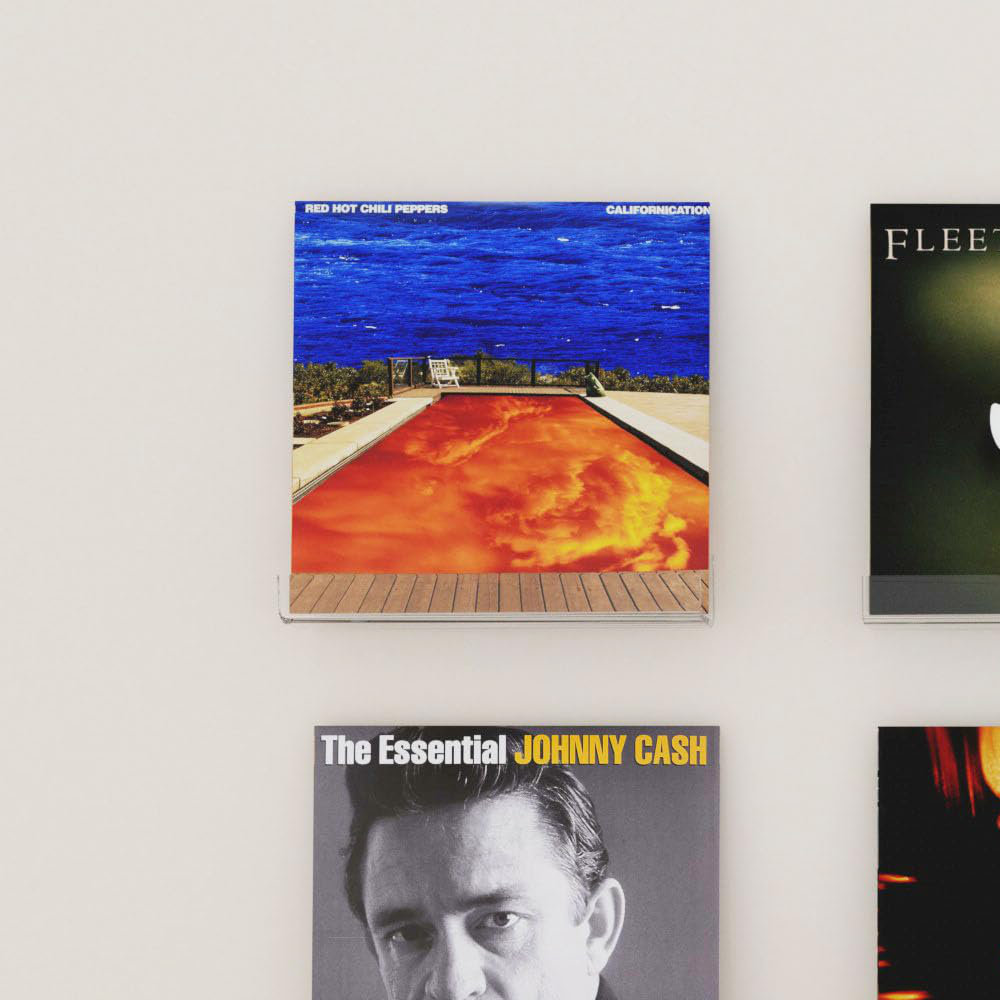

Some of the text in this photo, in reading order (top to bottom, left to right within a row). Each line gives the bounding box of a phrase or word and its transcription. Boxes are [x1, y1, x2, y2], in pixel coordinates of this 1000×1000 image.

[304, 203, 448, 214] RED HOT CHILI PEPPERS
[606, 205, 711, 215] CALIFORNICATION
[321, 733, 708, 765] The Essential JOHNNY CASH
